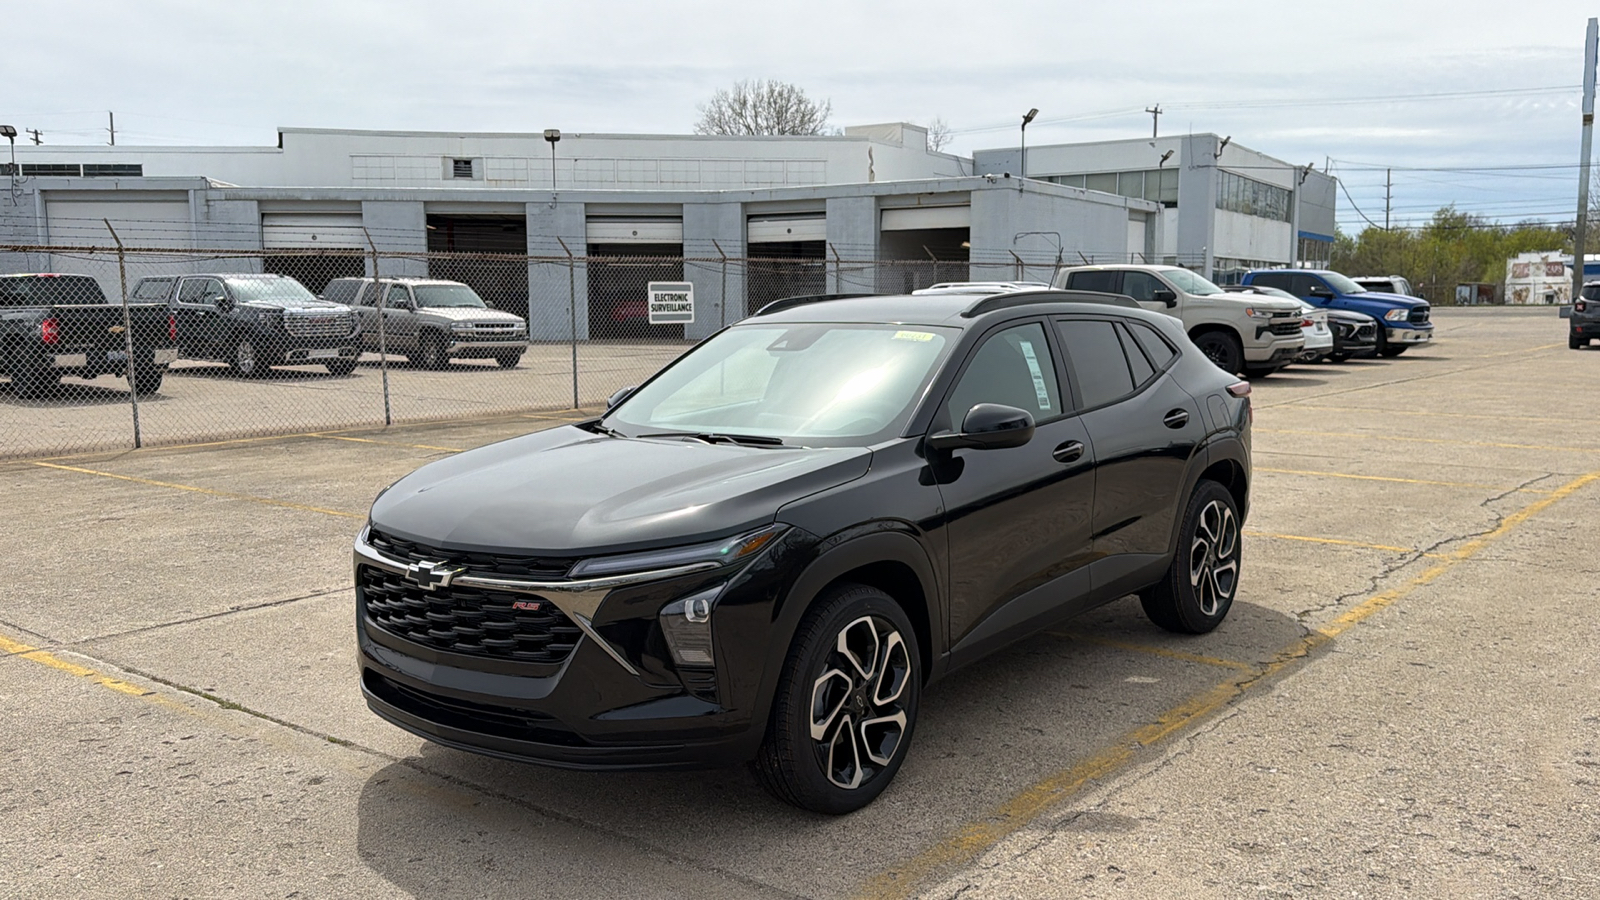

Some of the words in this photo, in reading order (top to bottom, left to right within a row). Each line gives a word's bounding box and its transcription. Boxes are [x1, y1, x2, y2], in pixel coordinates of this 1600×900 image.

[654, 293, 688, 302] ELECTRONIC
[651, 303, 692, 312] SURVEILLANCE
[512, 601, 540, 610] RS
